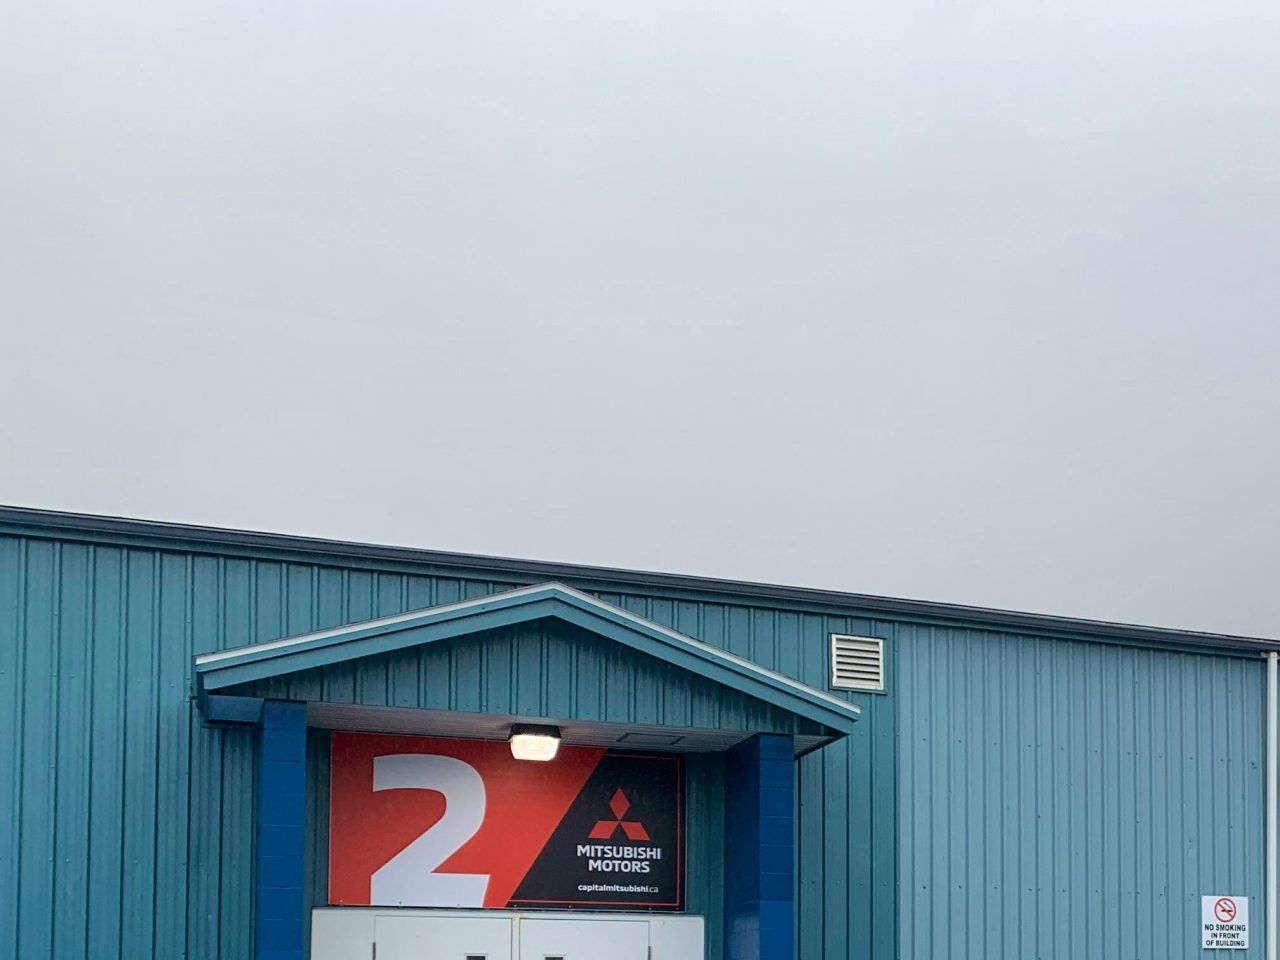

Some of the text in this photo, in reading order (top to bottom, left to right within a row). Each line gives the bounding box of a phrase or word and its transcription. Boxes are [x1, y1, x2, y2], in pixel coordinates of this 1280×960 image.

[370, 753, 490, 907] 2
[577, 844, 662, 860] MITSUBISHI
[588, 859, 651, 874] MOTORS
[577, 883, 659, 894] capitalmitsubishi.ca
[1215, 924, 1246, 932] SMOKING
